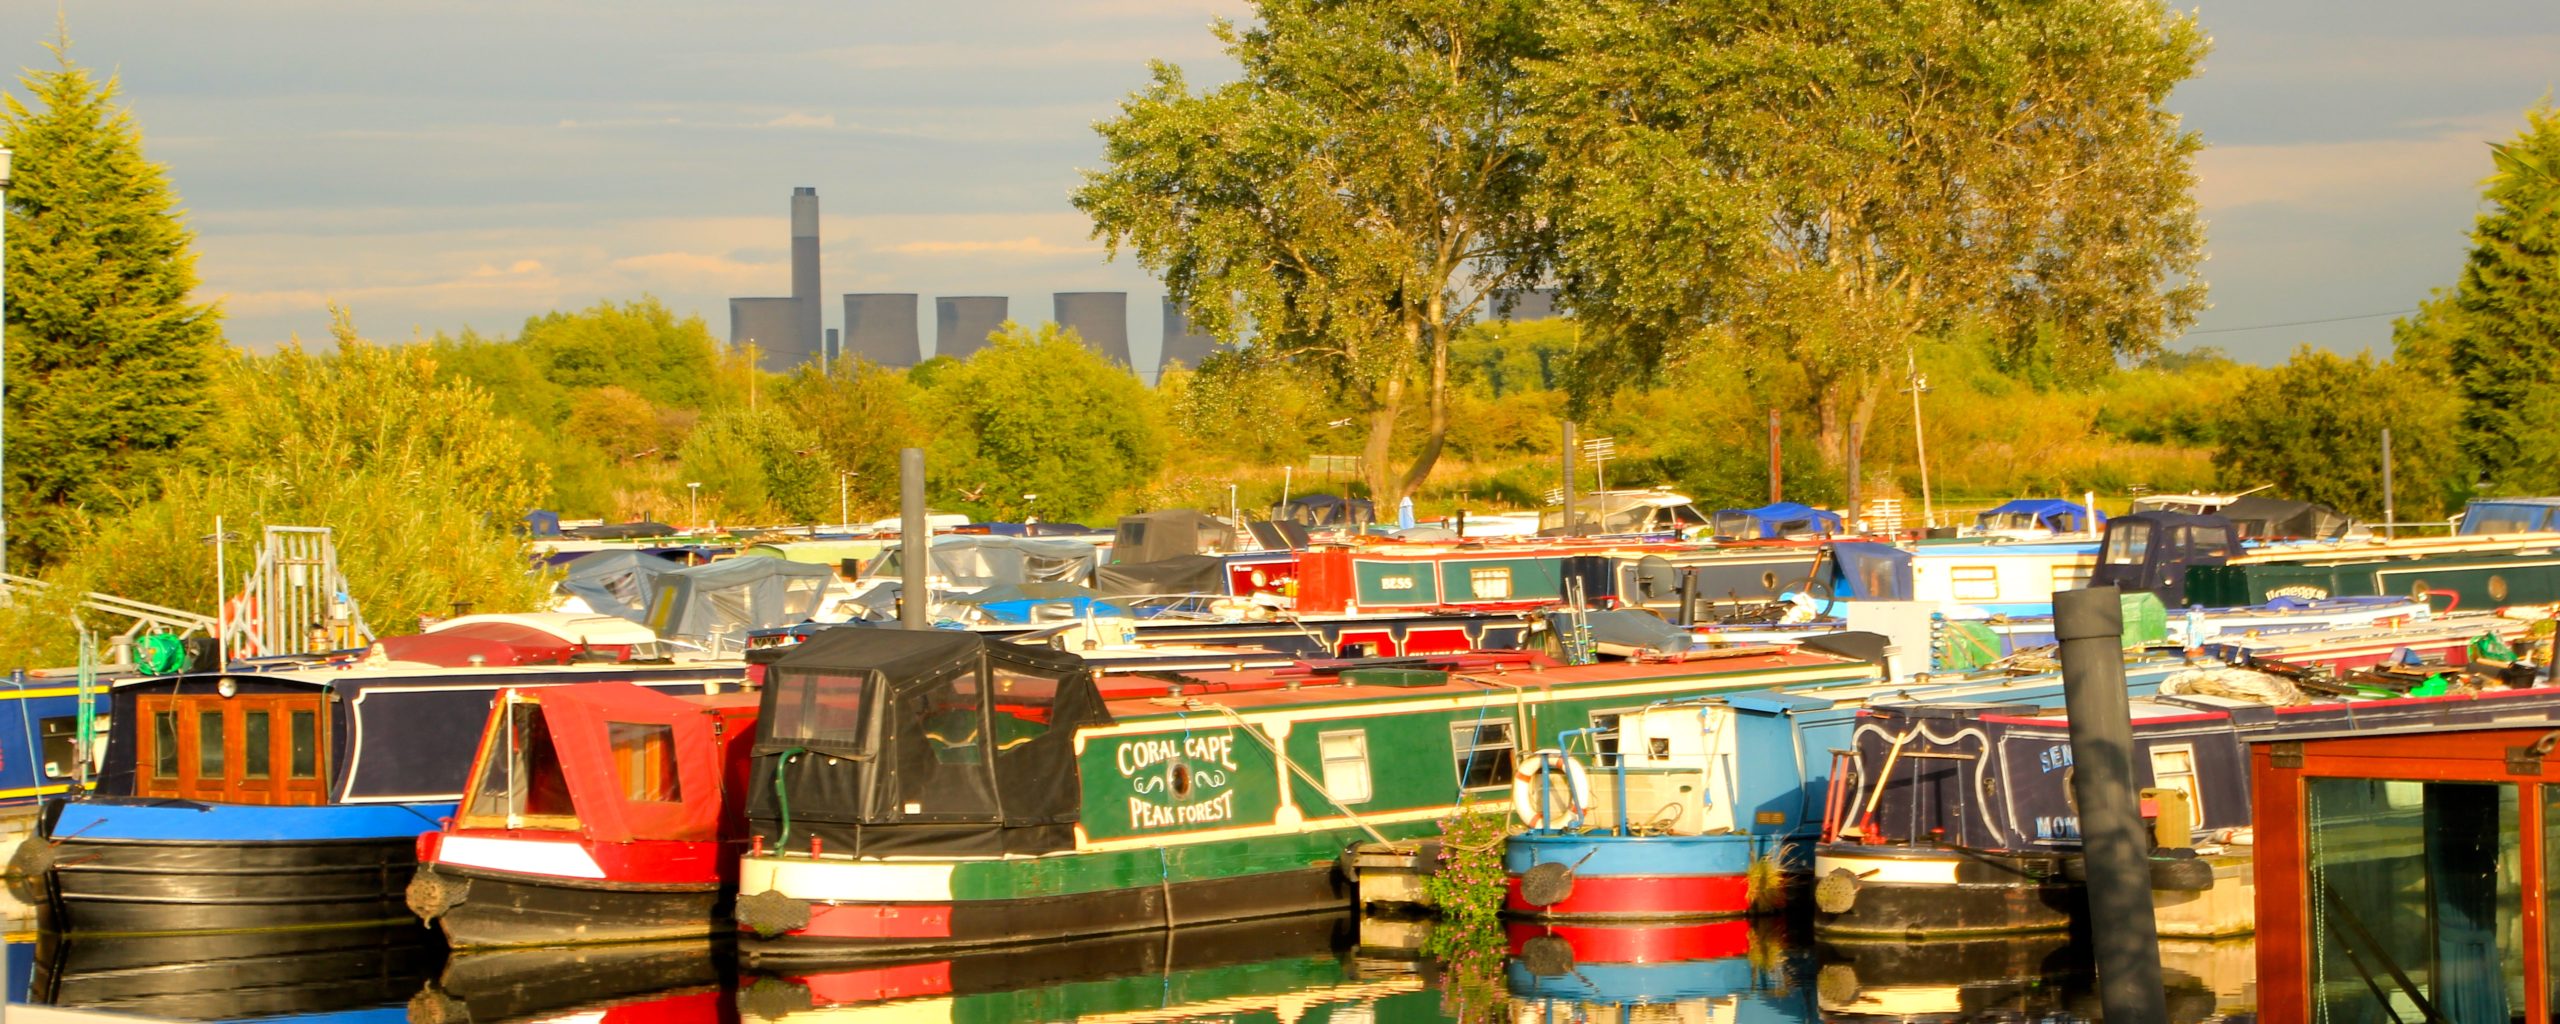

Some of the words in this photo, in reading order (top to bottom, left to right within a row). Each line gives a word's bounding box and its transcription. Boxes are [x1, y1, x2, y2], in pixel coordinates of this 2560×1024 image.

[1381, 576, 1413, 590] BESS
[1117, 739, 1181, 778] CORAL
[1184, 735, 1237, 771] CAPE
[2040, 744, 2073, 774] SEN
[1128, 796, 1175, 830] PEAK
[1177, 789, 1233, 824] FOREST
[2035, 816, 2081, 838] MOM
